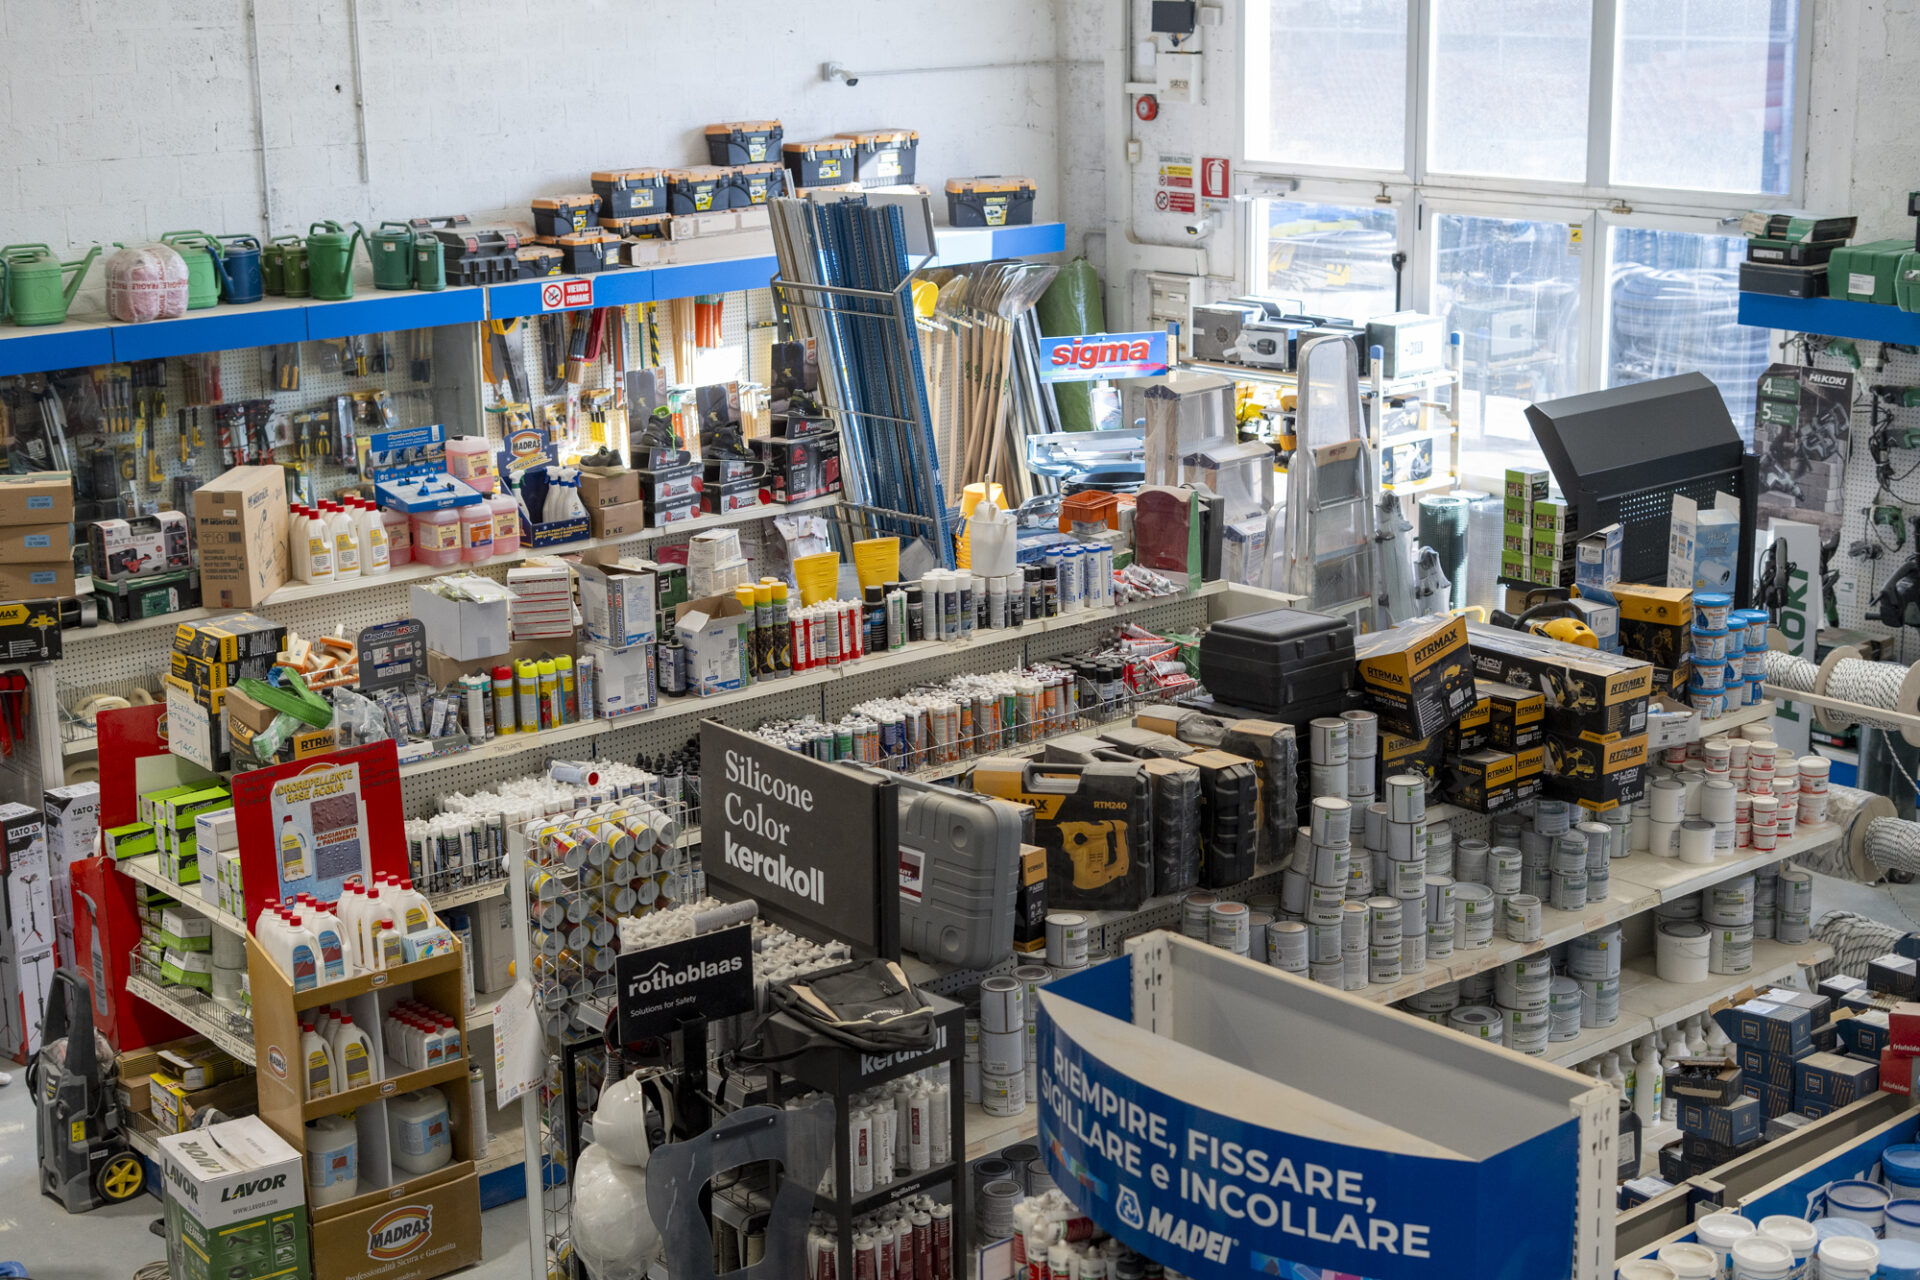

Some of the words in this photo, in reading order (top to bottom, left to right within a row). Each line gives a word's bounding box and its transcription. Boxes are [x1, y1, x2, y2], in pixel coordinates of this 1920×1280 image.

[566, 283, 588, 294] VIETATO
[566, 293, 590, 305] FUMARE
[1051, 337, 1150, 369] sigma
[1762, 377, 1773, 395] 4
[1808, 373, 1848, 386] HiKOKI
[1761, 403, 1772, 420] 5
[511, 439, 542, 452] MADRAS
[363, 631, 397, 641] Mapeflex
[397, 626, 409, 636] MS
[1414, 628, 1458, 662] RTRMAX
[1367, 666, 1404, 684] RTRMAX
[1610, 675, 1647, 694] RTRMAX
[1608, 743, 1644, 761] RTRMAX
[1487, 764, 1513, 778] RTRMAX
[275, 768, 354, 797] IDROREPELLENTE
[724, 749, 814, 812] Silicone
[286, 791, 311, 805] BASE
[312, 782, 345, 797] ACQUA
[71, 805, 94, 816] YATO
[1093, 801, 1128, 810] RTM240
[724, 791, 791, 847] Color
[9, 826, 31, 838] YATO
[316, 827, 357, 841] FACCIAVISTA
[322, 833, 358, 846] PAVIMENTI
[724, 830, 825, 905] kerakoll
[628, 956, 743, 997] rothoblaas
[630, 1004, 663, 1018] Solutions
[664, 1000, 674, 1009] for
[675, 995, 697, 1007] Safety
[1052, 1042, 1178, 1158] RIEMPIRE,
[1188, 1132, 1377, 1214] FISSARE,
[1041, 1074, 1142, 1180] SIGILLARE
[1150, 1166, 1172, 1191] e
[1180, 1169, 1431, 1260] INCOLLARE
[164, 1158, 199, 1204] LAVOR
[221, 1173, 287, 1203] LAVOR
[370, 1217, 430, 1250] MADRAS
[1147, 1206, 1233, 1265] MAPEI
[396, 1256, 419, 1268] Sicura
